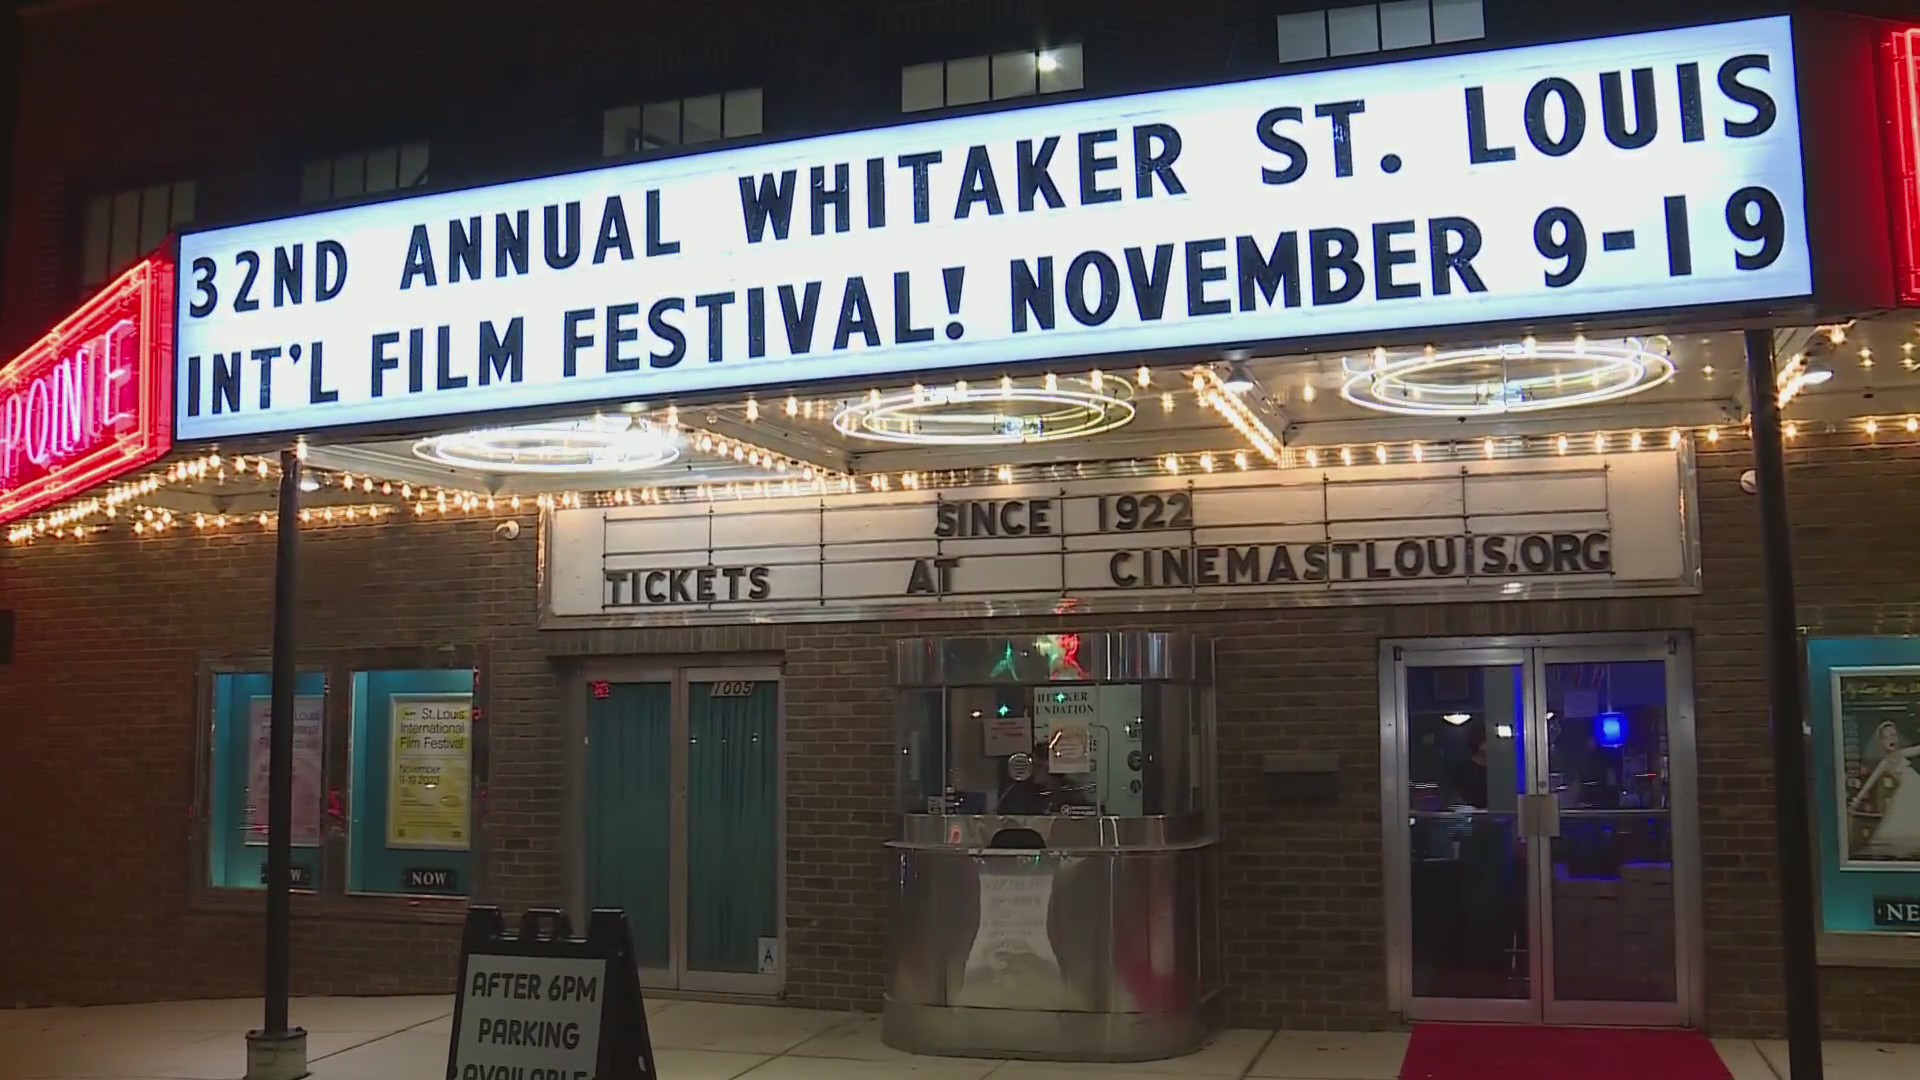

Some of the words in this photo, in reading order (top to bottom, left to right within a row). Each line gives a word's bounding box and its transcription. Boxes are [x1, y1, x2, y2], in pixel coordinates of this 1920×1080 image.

[189, 239, 348, 319] 32ND
[399, 188, 681, 290] ANNUAL
[738, 123, 1187, 244] WHITAKER
[1256, 99, 1402, 185] ST.
[1464, 53, 1777, 165] LOUIS
[187, 341, 339, 418] INT'L
[371, 316, 524, 398] FILM
[563, 265, 966, 378] FESTIVAL!
[1010, 216, 1489, 334] NOVEMBER
[1533, 185, 1785, 289] 9-19
[0, 317, 137, 480] POINTE
[936, 499, 1051, 537] SINCE
[1099, 492, 1192, 532] 1922
[605, 566, 771, 603] TICKETS
[907, 558, 959, 596] AT
[1110, 533, 1611, 588] CINEMASTLOUIS.ORG
[713, 681, 752, 696] 1005
[1037, 691, 1088, 703] HITKER
[437, 708, 465, 720] Louis
[400, 723, 465, 734] International
[400, 736, 420, 749] Film
[424, 736, 464, 749] Festival
[399, 764, 441, 774] November
[411, 871, 447, 886] NOW
[471, 971, 542, 1000] AFTER
[547, 974, 598, 1003] 6PM
[477, 1018, 581, 1049] PARKING
